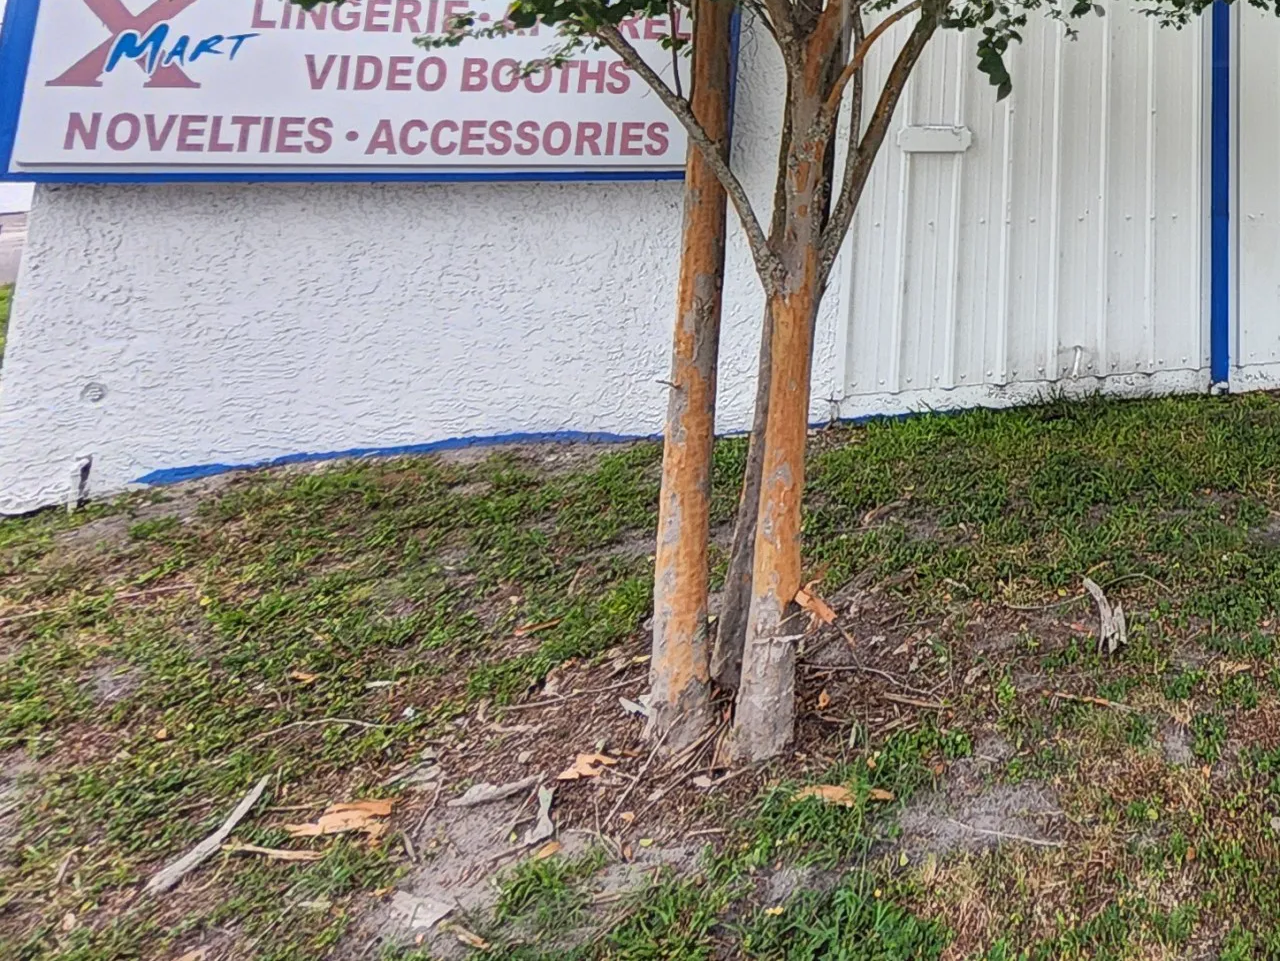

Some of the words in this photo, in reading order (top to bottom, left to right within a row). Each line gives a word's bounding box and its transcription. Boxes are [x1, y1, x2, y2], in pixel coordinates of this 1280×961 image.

[104, 23, 261, 74] MART
[304, 54, 448, 92] VIDEO
[459, 57, 632, 94] BOOTHS
[63, 111, 333, 154] NOVELTIES
[365, 118, 671, 157] ACCESSORIES
